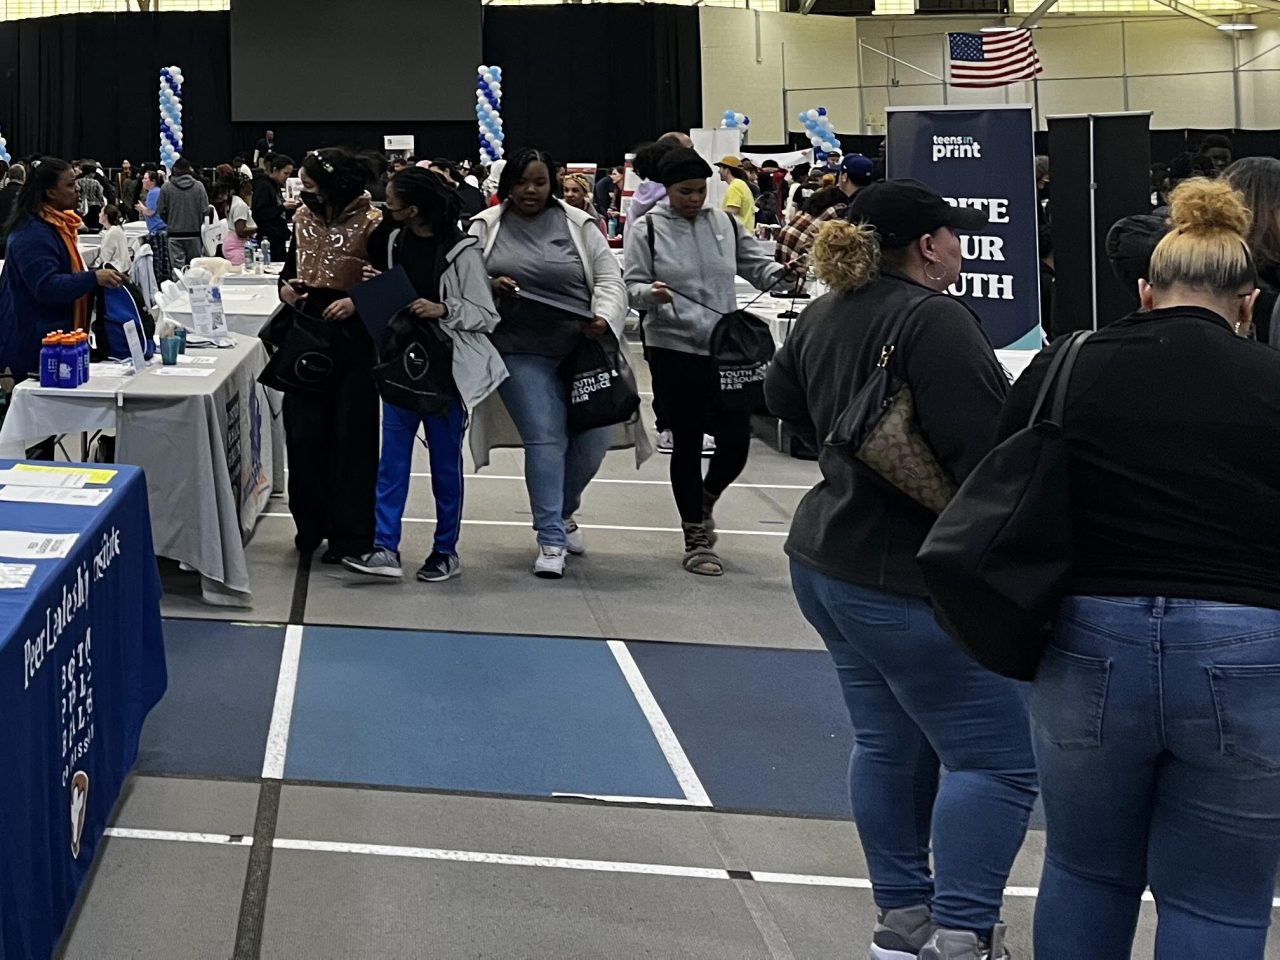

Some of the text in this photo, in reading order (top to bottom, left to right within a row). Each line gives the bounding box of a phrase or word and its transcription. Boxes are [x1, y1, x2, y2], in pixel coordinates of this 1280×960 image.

[933, 135, 963, 145] teens
[932, 141, 981, 162] print
[959, 235, 1006, 261] UR
[945, 272, 1015, 300] UTH
[573, 376, 596, 388] OUTH
[720, 376, 764, 384] RESOUR
[24, 628, 45, 691] Peer
[46, 561, 89, 653] Leaeshi
[93, 526, 121, 582] nstitute
